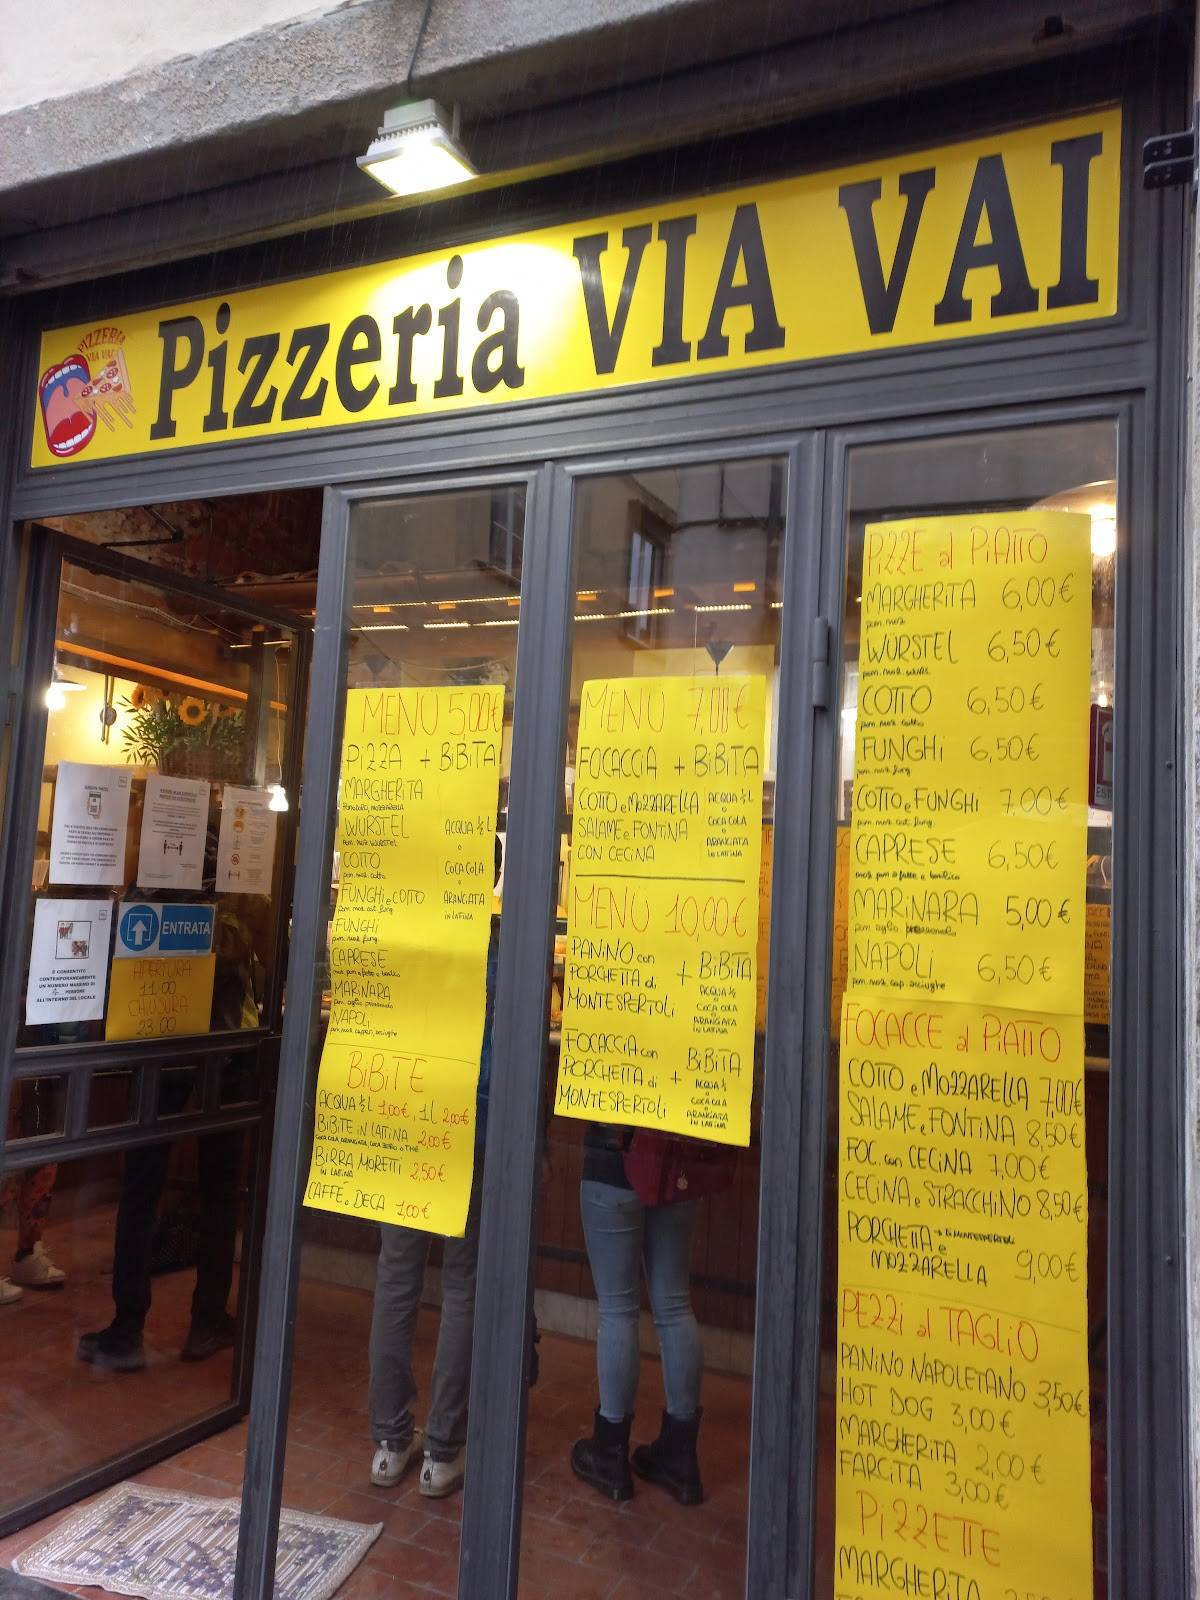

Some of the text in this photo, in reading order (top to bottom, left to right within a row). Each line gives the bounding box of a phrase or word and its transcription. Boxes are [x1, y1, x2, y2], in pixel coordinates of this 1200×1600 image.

[149, 132, 1103, 440] Pizzeria VIA VAI
[78, 327, 126, 352] PIZZERIA
[940, 532, 953, 570] al
[1002, 573, 1075, 612] 6,00€
[988, 627, 1061, 663] 6,50€
[687, 683, 752, 737] 7,00€
[862, 683, 1047, 716] COTTO 6,50€
[970, 733, 1041, 763] 6,50€
[578, 787, 699, 815] COTTO e MOZZARELLA
[856, 784, 902, 813] COTTO
[904, 803, 912, 813] e
[999, 786, 1071, 817] 7,00€
[444, 818, 474, 836] ACQUA
[578, 817, 625, 839] SALAME
[342, 852, 381, 869] COTTO
[577, 844, 603, 862] CON
[855, 832, 956, 866] CAPRESE
[988, 839, 1060, 872] 6,50€
[392, 889, 425, 906] COTTO
[1005, 895, 1072, 932] 5,00€
[162, 921, 211, 935] ENTRATA
[664, 893, 748, 943] 10,00€
[332, 947, 389, 968] CAPRESE
[569, 962, 640, 987] PORCHETTA
[977, 953, 1053, 985] 6,50€
[843, 1002, 943, 1050] FOCACCE
[563, 1055, 643, 1087] PORCHETTA
[848, 1057, 1083, 1119] COTTO e MOZZARELLA 7,00€
[319, 1089, 356, 1111] ACQUA
[442, 1106, 470, 1126] 2,00€
[847, 1090, 921, 1131] SALAME
[920, 1123, 928, 1136] e
[1026, 1119, 1082, 1152] 8,50€
[417, 1130, 452, 1150] 2,00€
[409, 1161, 447, 1183] 2,50€
[989, 1152, 1051, 1182] 7,00€
[353, 1189, 386, 1211] DECA
[394, 1200, 432, 1223] 1,00€
[1036, 1188, 1084, 1224] 8,50€
[847, 1210, 933, 1252] PORCHETTA
[871, 1248, 1080, 1288] MOZZARELLA 9,00€
[911, 1351, 1026, 1402] NAPOLETANO
[1033, 1379, 1088, 1418] 3,50€
[841, 1376, 1016, 1439] HOT DOG 3,00€
[975, 1443, 1047, 1485] 2,00€
[945, 1470, 1010, 1510] 3,00€
